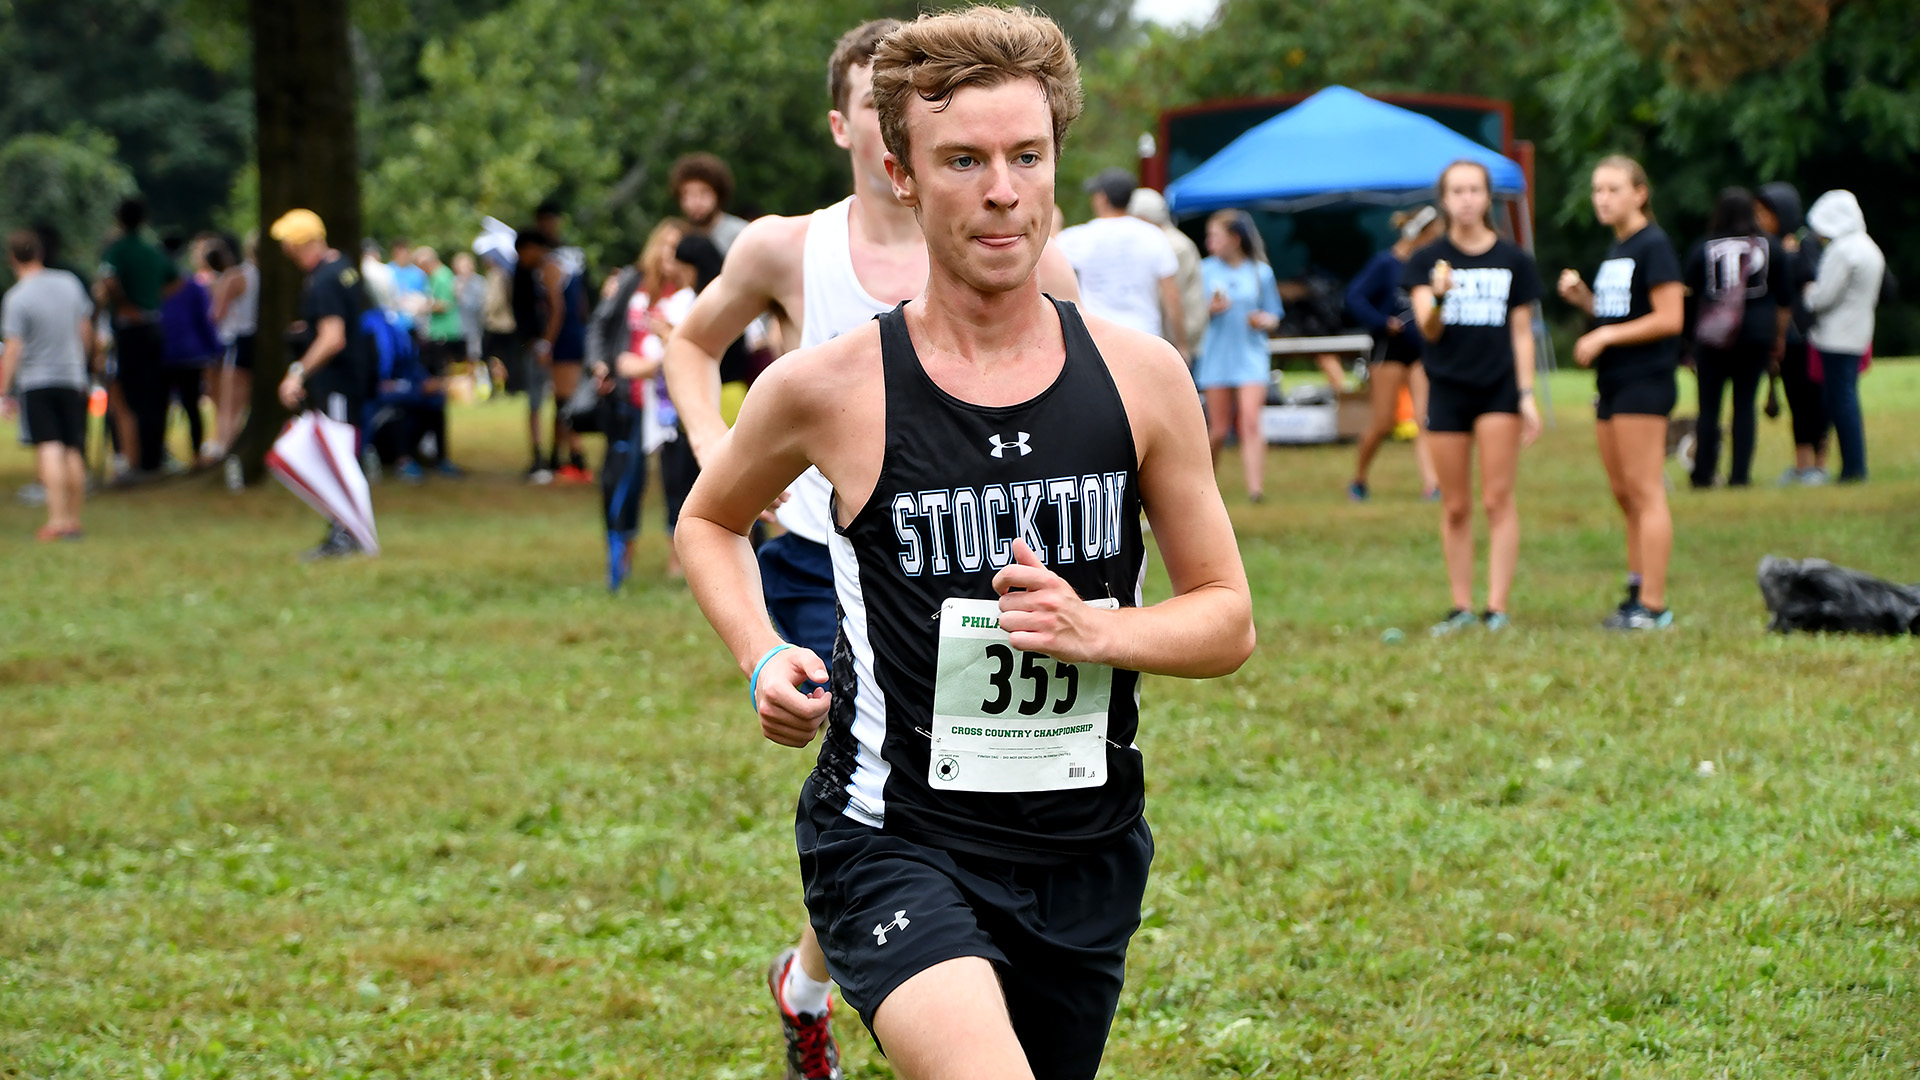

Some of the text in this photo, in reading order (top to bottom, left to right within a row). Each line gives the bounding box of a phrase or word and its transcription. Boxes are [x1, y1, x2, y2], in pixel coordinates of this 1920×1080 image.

[891, 471, 1127, 577] STOCKTON
[980, 643, 1079, 716] 355
[951, 723, 1094, 738] CROSS COUNTRY CHAMPIONSHIP
